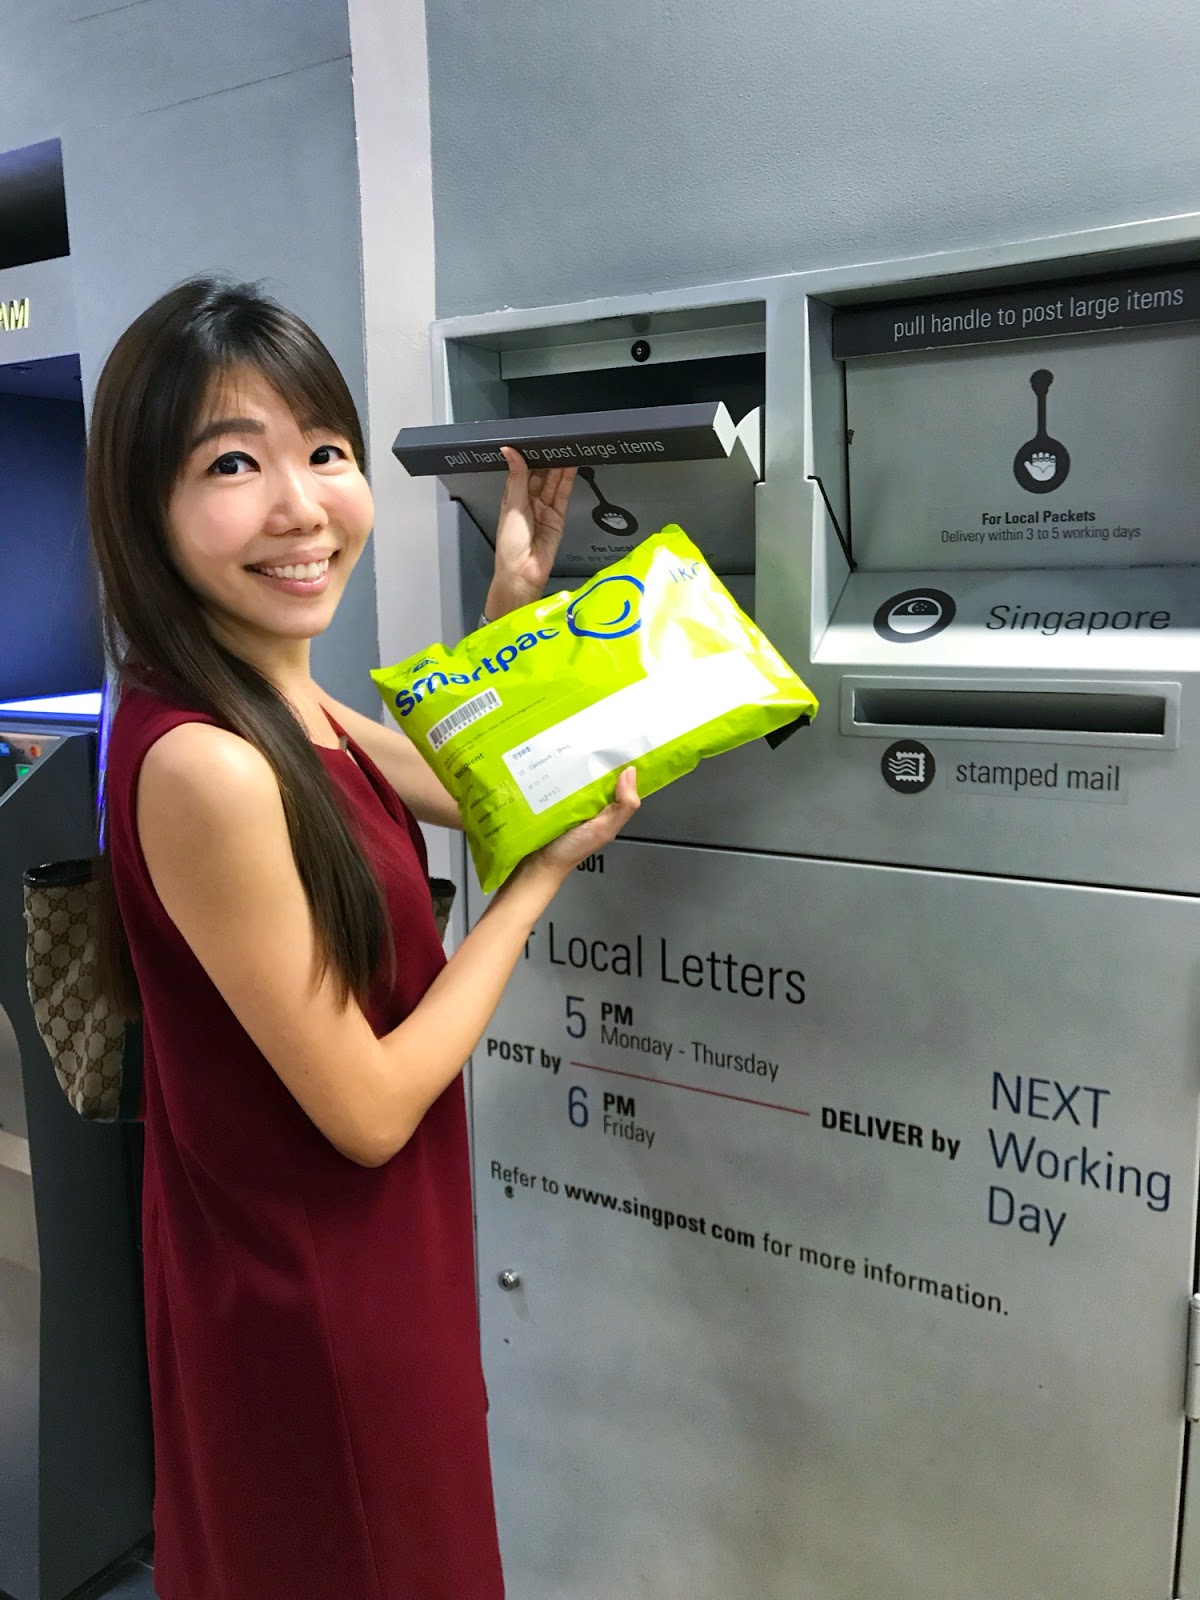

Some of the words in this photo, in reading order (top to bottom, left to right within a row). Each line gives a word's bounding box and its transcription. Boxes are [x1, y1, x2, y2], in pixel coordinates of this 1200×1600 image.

[895, 316, 924, 341] pull
[932, 309, 991, 332] handle
[997, 309, 1015, 325] to
[1023, 301, 1063, 328] post
[1070, 297, 1119, 319] large
[1127, 289, 1183, 310] items
[444, 451, 472, 467] pull
[522, 448, 540, 461] to
[542, 444, 577, 461] post
[579, 442, 617, 458] large
[619, 439, 665, 454] items
[942, 531, 985, 544] Delivery
[988, 529, 1023, 541] within
[1027, 528, 1034, 540] 3
[1038, 530, 1049, 540] to
[1052, 527, 1059, 539] 5
[1062, 527, 1109, 541] working
[1113, 526, 1141, 540] days
[982, 513, 1001, 525] For
[1005, 511, 1039, 524] Local
[1043, 510, 1095, 522] Packets
[985, 605, 1172, 635] Singapore
[956, 762, 1057, 791] stamped
[1068, 765, 1119, 790] mail
[550, 923, 642, 977] Local
[661, 938, 805, 1004] Letters
[566, 996, 586, 1038] 5
[602, 1003, 632, 1025] PM
[488, 1039, 535, 1064] POST
[541, 1049, 561, 1074] by
[601, 1024, 673, 1061] Monday
[691, 1042, 778, 1082] Thursday
[569, 1086, 588, 1127] 6
[604, 1093, 635, 1117] PM
[991, 1072, 1110, 1128] NEXT
[604, 1116, 655, 1148] Friday
[822, 1107, 922, 1147] DELIVER
[932, 1129, 960, 1160] by
[988, 1127, 1170, 1212] Working
[989, 1186, 1066, 1247] Day
[491, 1161, 536, 1190] Refer
[542, 1177, 558, 1194] to
[763, 1233, 792, 1257] for
[800, 1247, 855, 1274] more
[864, 1258, 1008, 1315] information.
